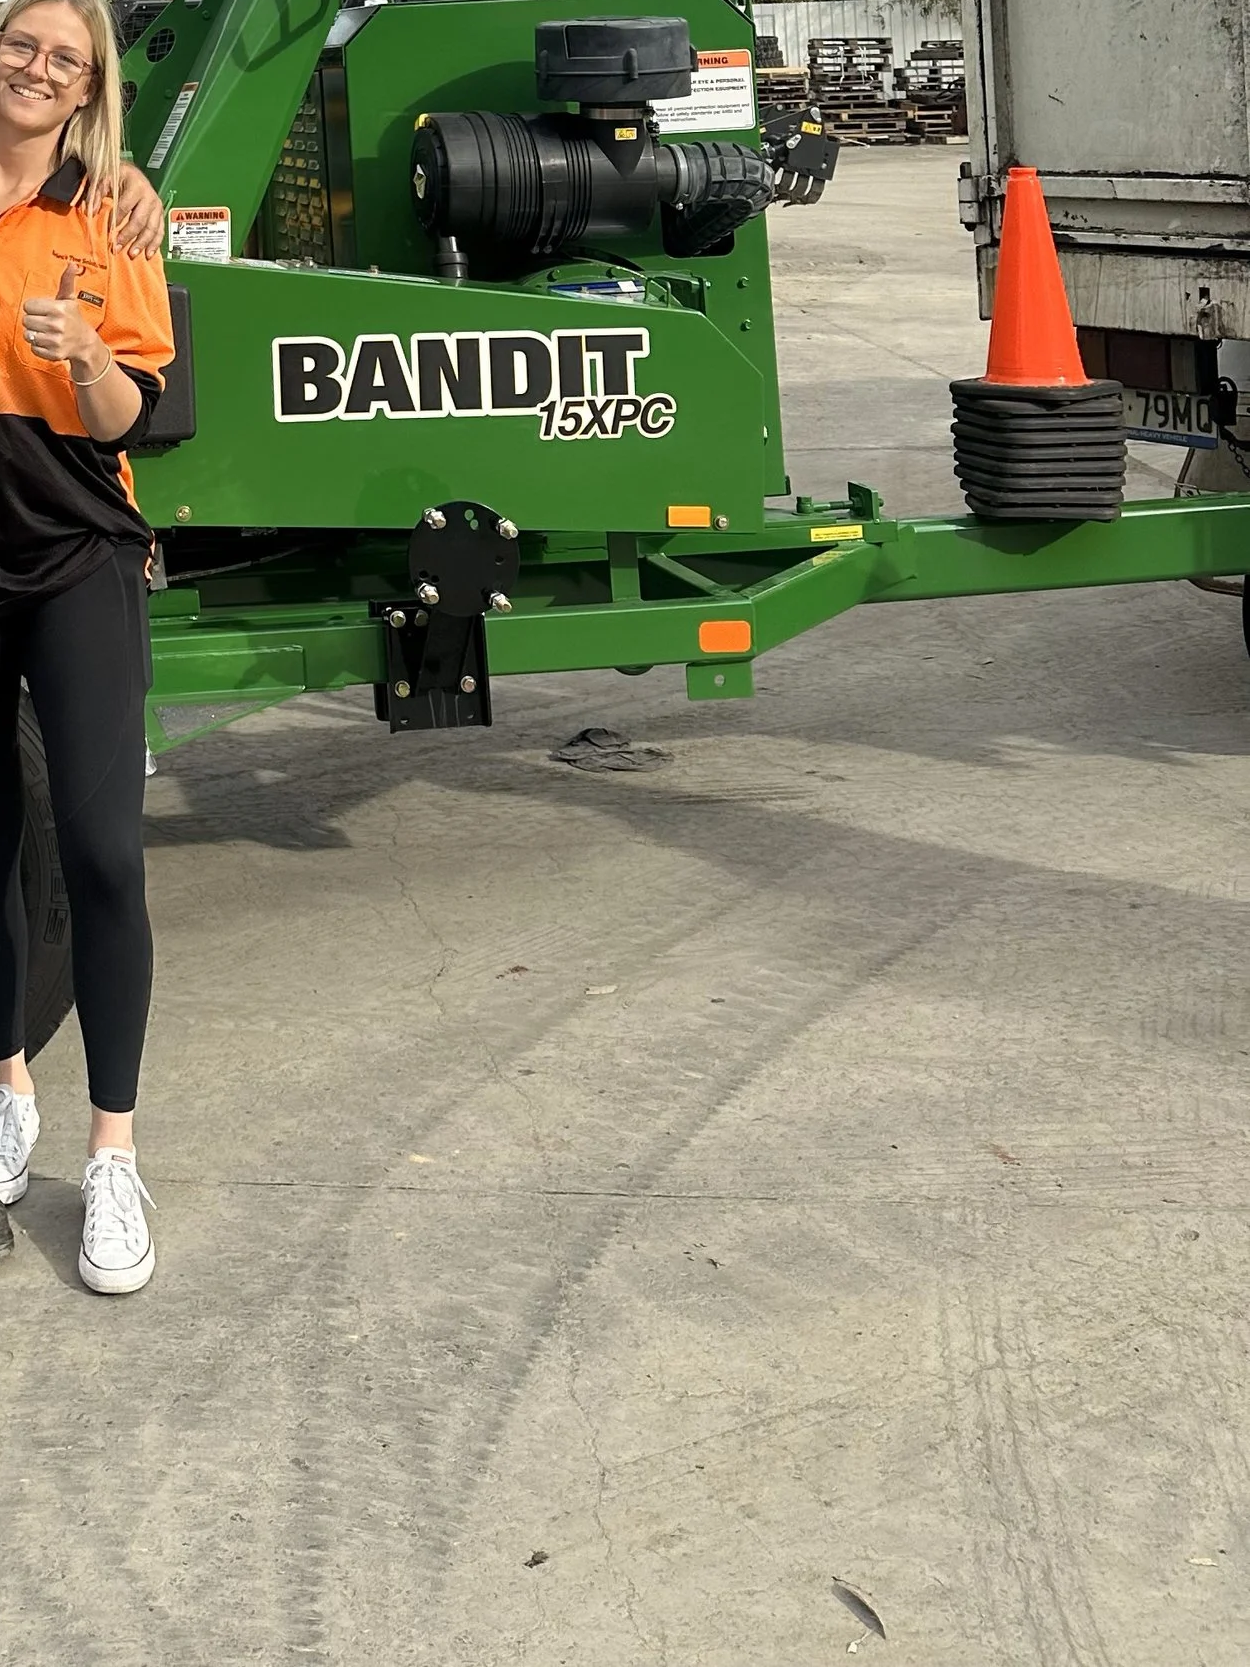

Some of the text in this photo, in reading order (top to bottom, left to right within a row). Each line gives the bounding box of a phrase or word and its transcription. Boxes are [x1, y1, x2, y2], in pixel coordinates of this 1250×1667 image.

[697, 57, 729, 66] RNING
[184, 212, 225, 220] WARNING
[276, 332, 645, 418] BANDIT
[539, 396, 674, 437] 15XPC
